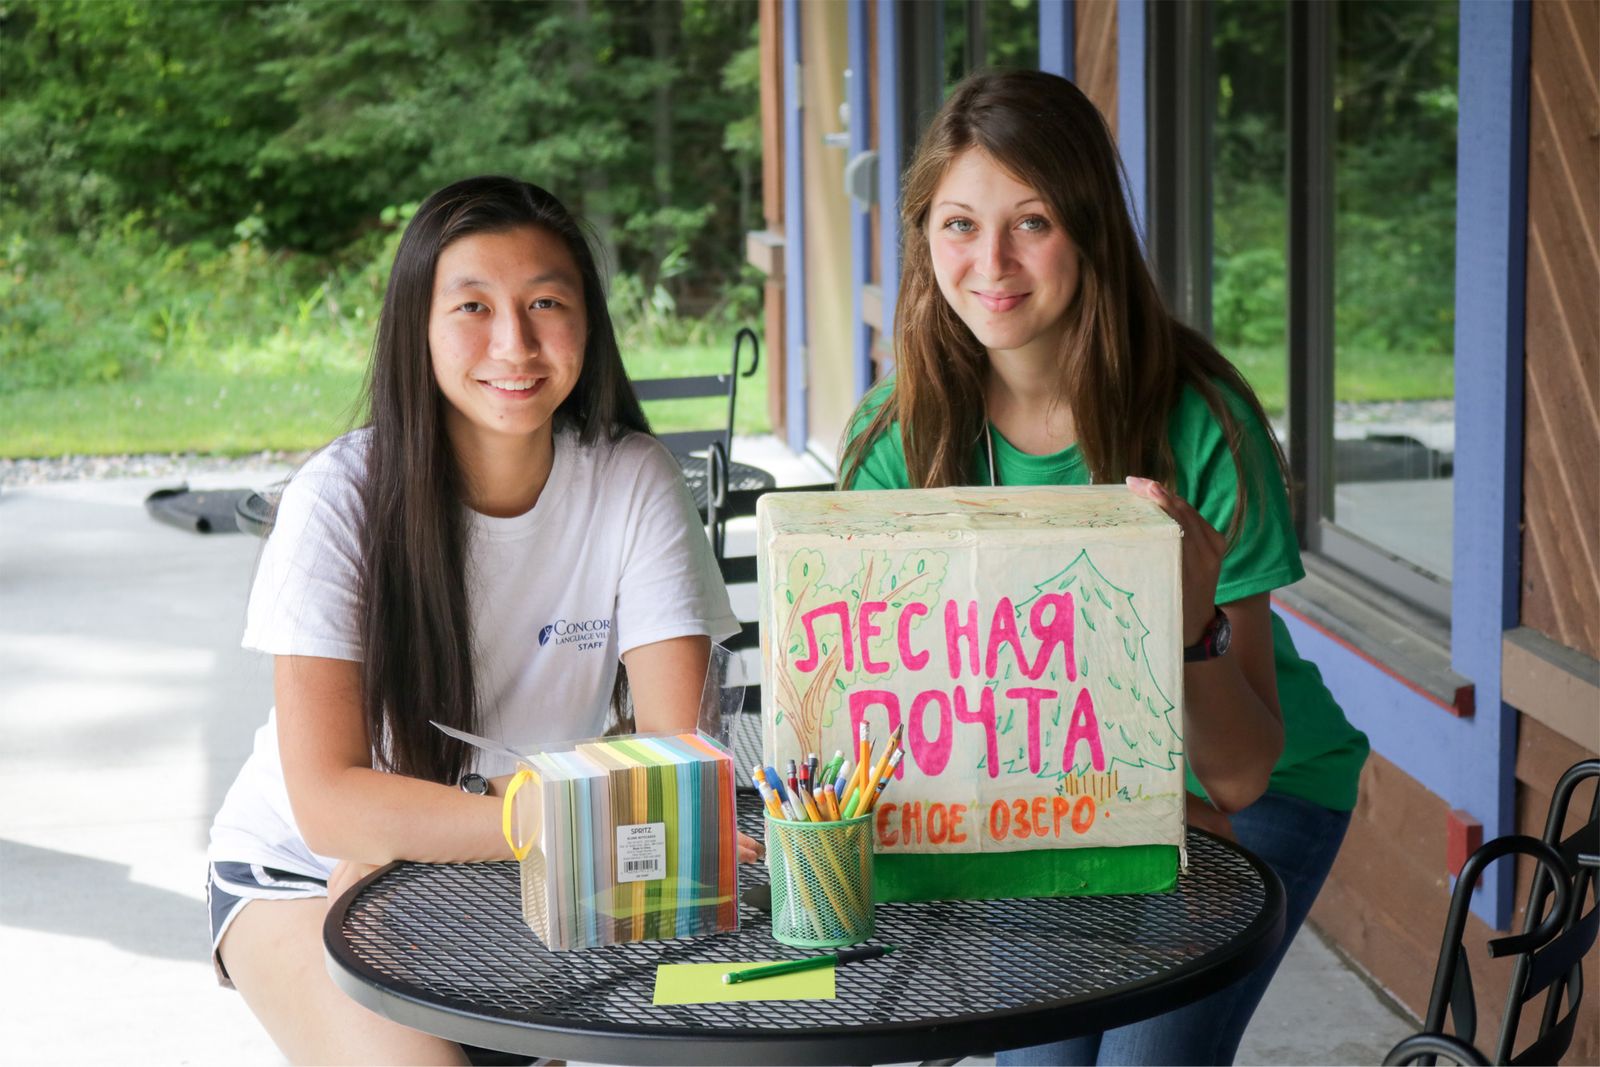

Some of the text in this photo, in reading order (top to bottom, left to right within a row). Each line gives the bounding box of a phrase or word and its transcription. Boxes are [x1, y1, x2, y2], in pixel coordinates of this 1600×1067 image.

[554, 619, 611, 636] CONCOR
[556, 633, 594, 645] LANGUAGE
[795, 591, 1077, 682] ЛЕСНАЯ
[578, 641, 603, 651] STAFF
[849, 685, 1105, 781] ПОЧТА
[630, 827, 652, 835] SPRITZ
[876, 800, 968, 847] СНОЕ
